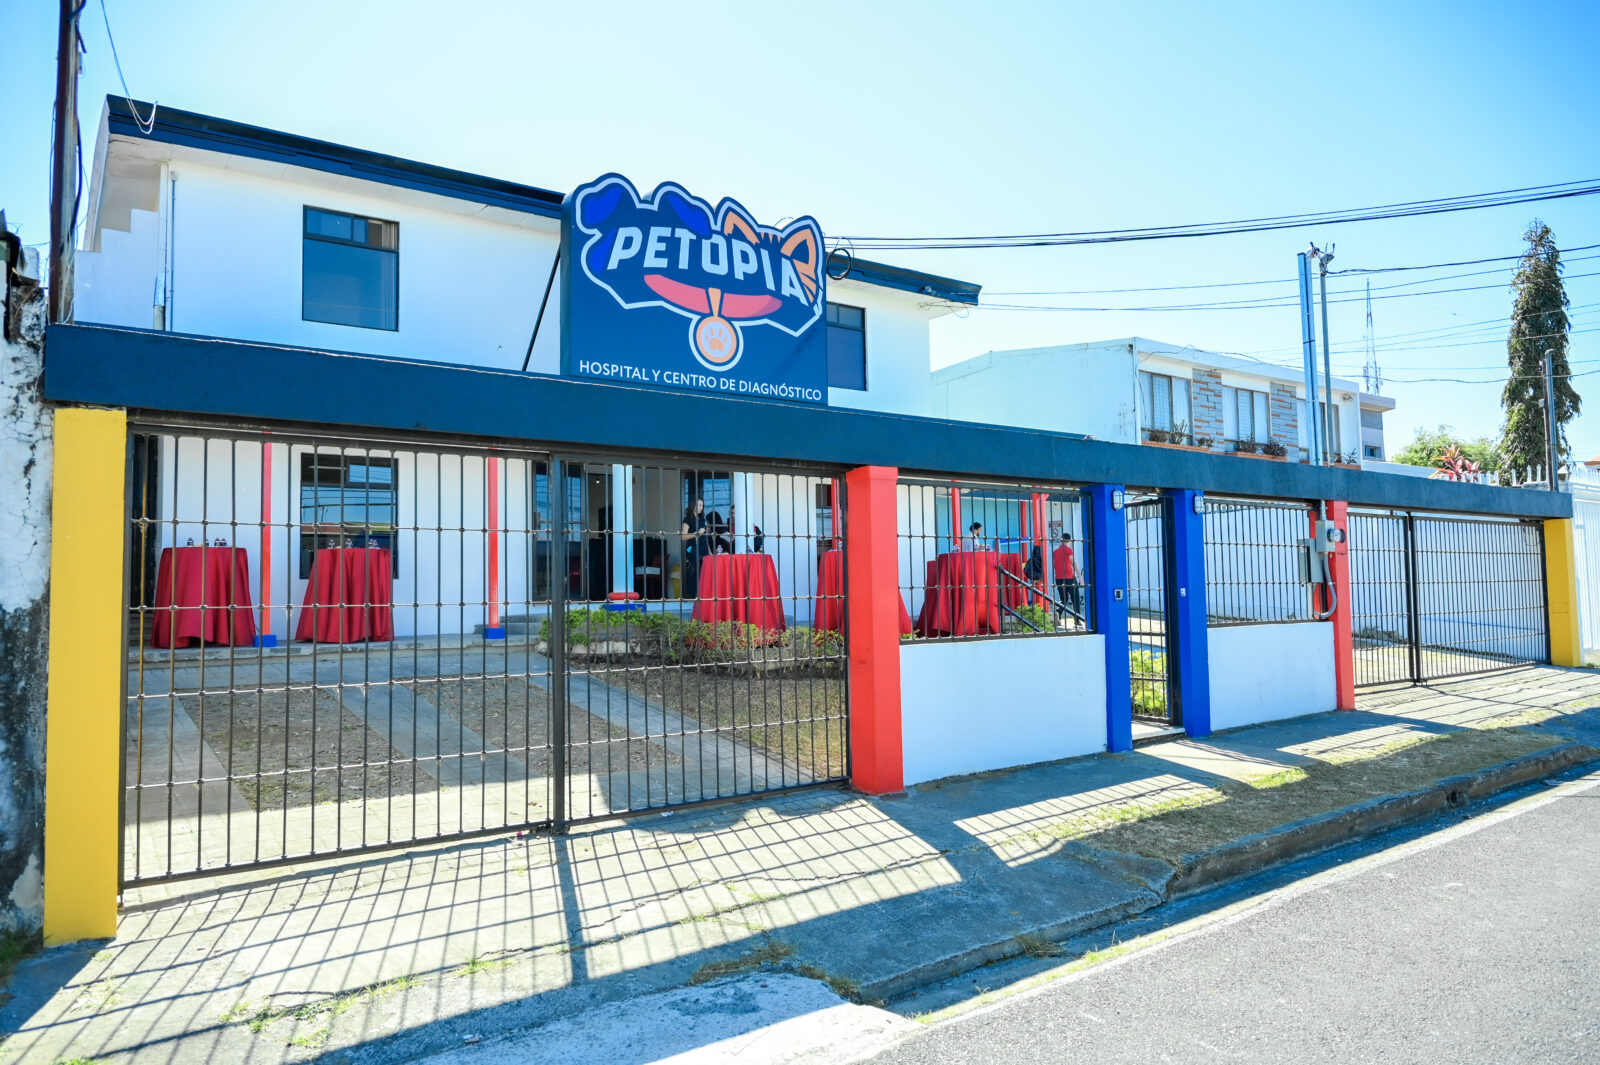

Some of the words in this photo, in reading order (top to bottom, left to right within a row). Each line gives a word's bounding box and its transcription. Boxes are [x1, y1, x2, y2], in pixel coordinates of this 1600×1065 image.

[607, 226, 809, 307] PETOPIA
[579, 360, 650, 381] HOSPITAL
[652, 369, 661, 382] Y
[663, 371, 717, 388] CENTRO
[720, 378, 736, 391] DE
[739, 380, 822, 400] DIAGNÓSTICO
